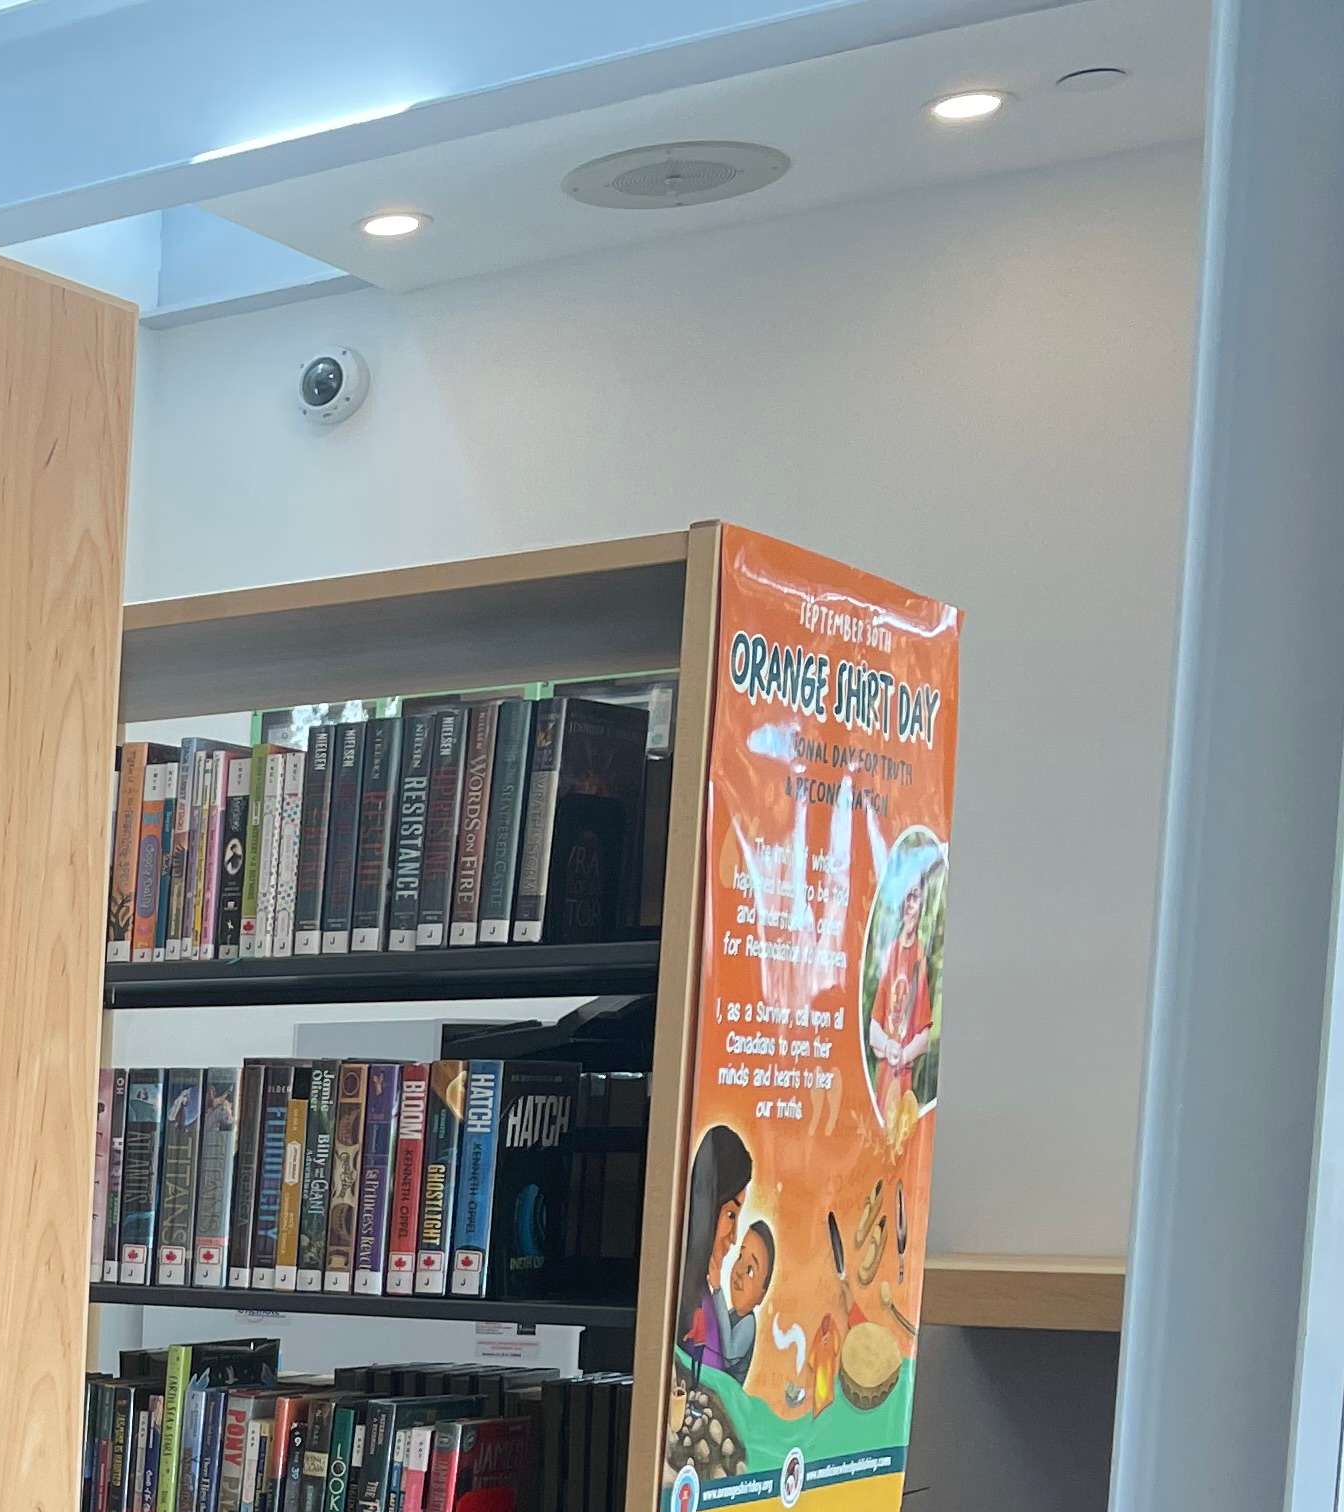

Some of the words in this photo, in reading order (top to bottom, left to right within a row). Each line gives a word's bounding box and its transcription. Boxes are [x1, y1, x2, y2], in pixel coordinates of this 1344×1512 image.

[800, 602, 864, 643] SEPTEMBER
[866, 624, 892, 653] 30TH
[730, 631, 830, 722] ORANGE
[897, 682, 940, 749] DAY
[314, 732, 329, 771] NIELSEN
[342, 729, 357, 768] NIELSEN
[440, 716, 454, 755] NIELSEN
[832, 748, 855, 769] DAY
[859, 751, 879, 773] FOR
[881, 755, 913, 785] TRUTH
[464, 755, 486, 835] WORDS
[796, 777, 889, 817] RECONCIATION
[395, 776, 427, 901] RESISTANCE
[457, 855, 478, 905] FIRE
[817, 881, 829, 901] be
[737, 905, 755, 924] and
[723, 931, 742, 955] for
[727, 1002, 740, 1022] as
[744, 1004, 752, 1022] a
[726, 1030, 775, 1056] Canadians
[779, 1035, 788, 1056] to
[791, 1040, 810, 1064] open
[813, 1035, 832, 1058] their
[311, 1069, 321, 1112] Oliver
[321, 1069, 335, 1112] Jamie
[718, 1062, 750, 1087] minds
[753, 1064, 771, 1086] and
[774, 1064, 800, 1088] hearts
[803, 1068, 813, 1088] to
[815, 1065, 834, 1089] hear
[399, 1080, 426, 1140] BLOOM
[466, 1073, 495, 1133] HATCH
[505, 1095, 571, 1149] HATCH
[756, 1101, 774, 1118] our
[125, 1130, 152, 1204] ATLANTIS
[317, 1134, 330, 1164] Billy
[163, 1137, 193, 1244] TITANS
[401, 1149, 413, 1201] KENNETH
[469, 1142, 483, 1200] KENNETH
[422, 1163, 446, 1246] GHOSTLIGHT
[224, 1408, 246, 1467] PONY
[364, 1481, 379, 1498] THE
